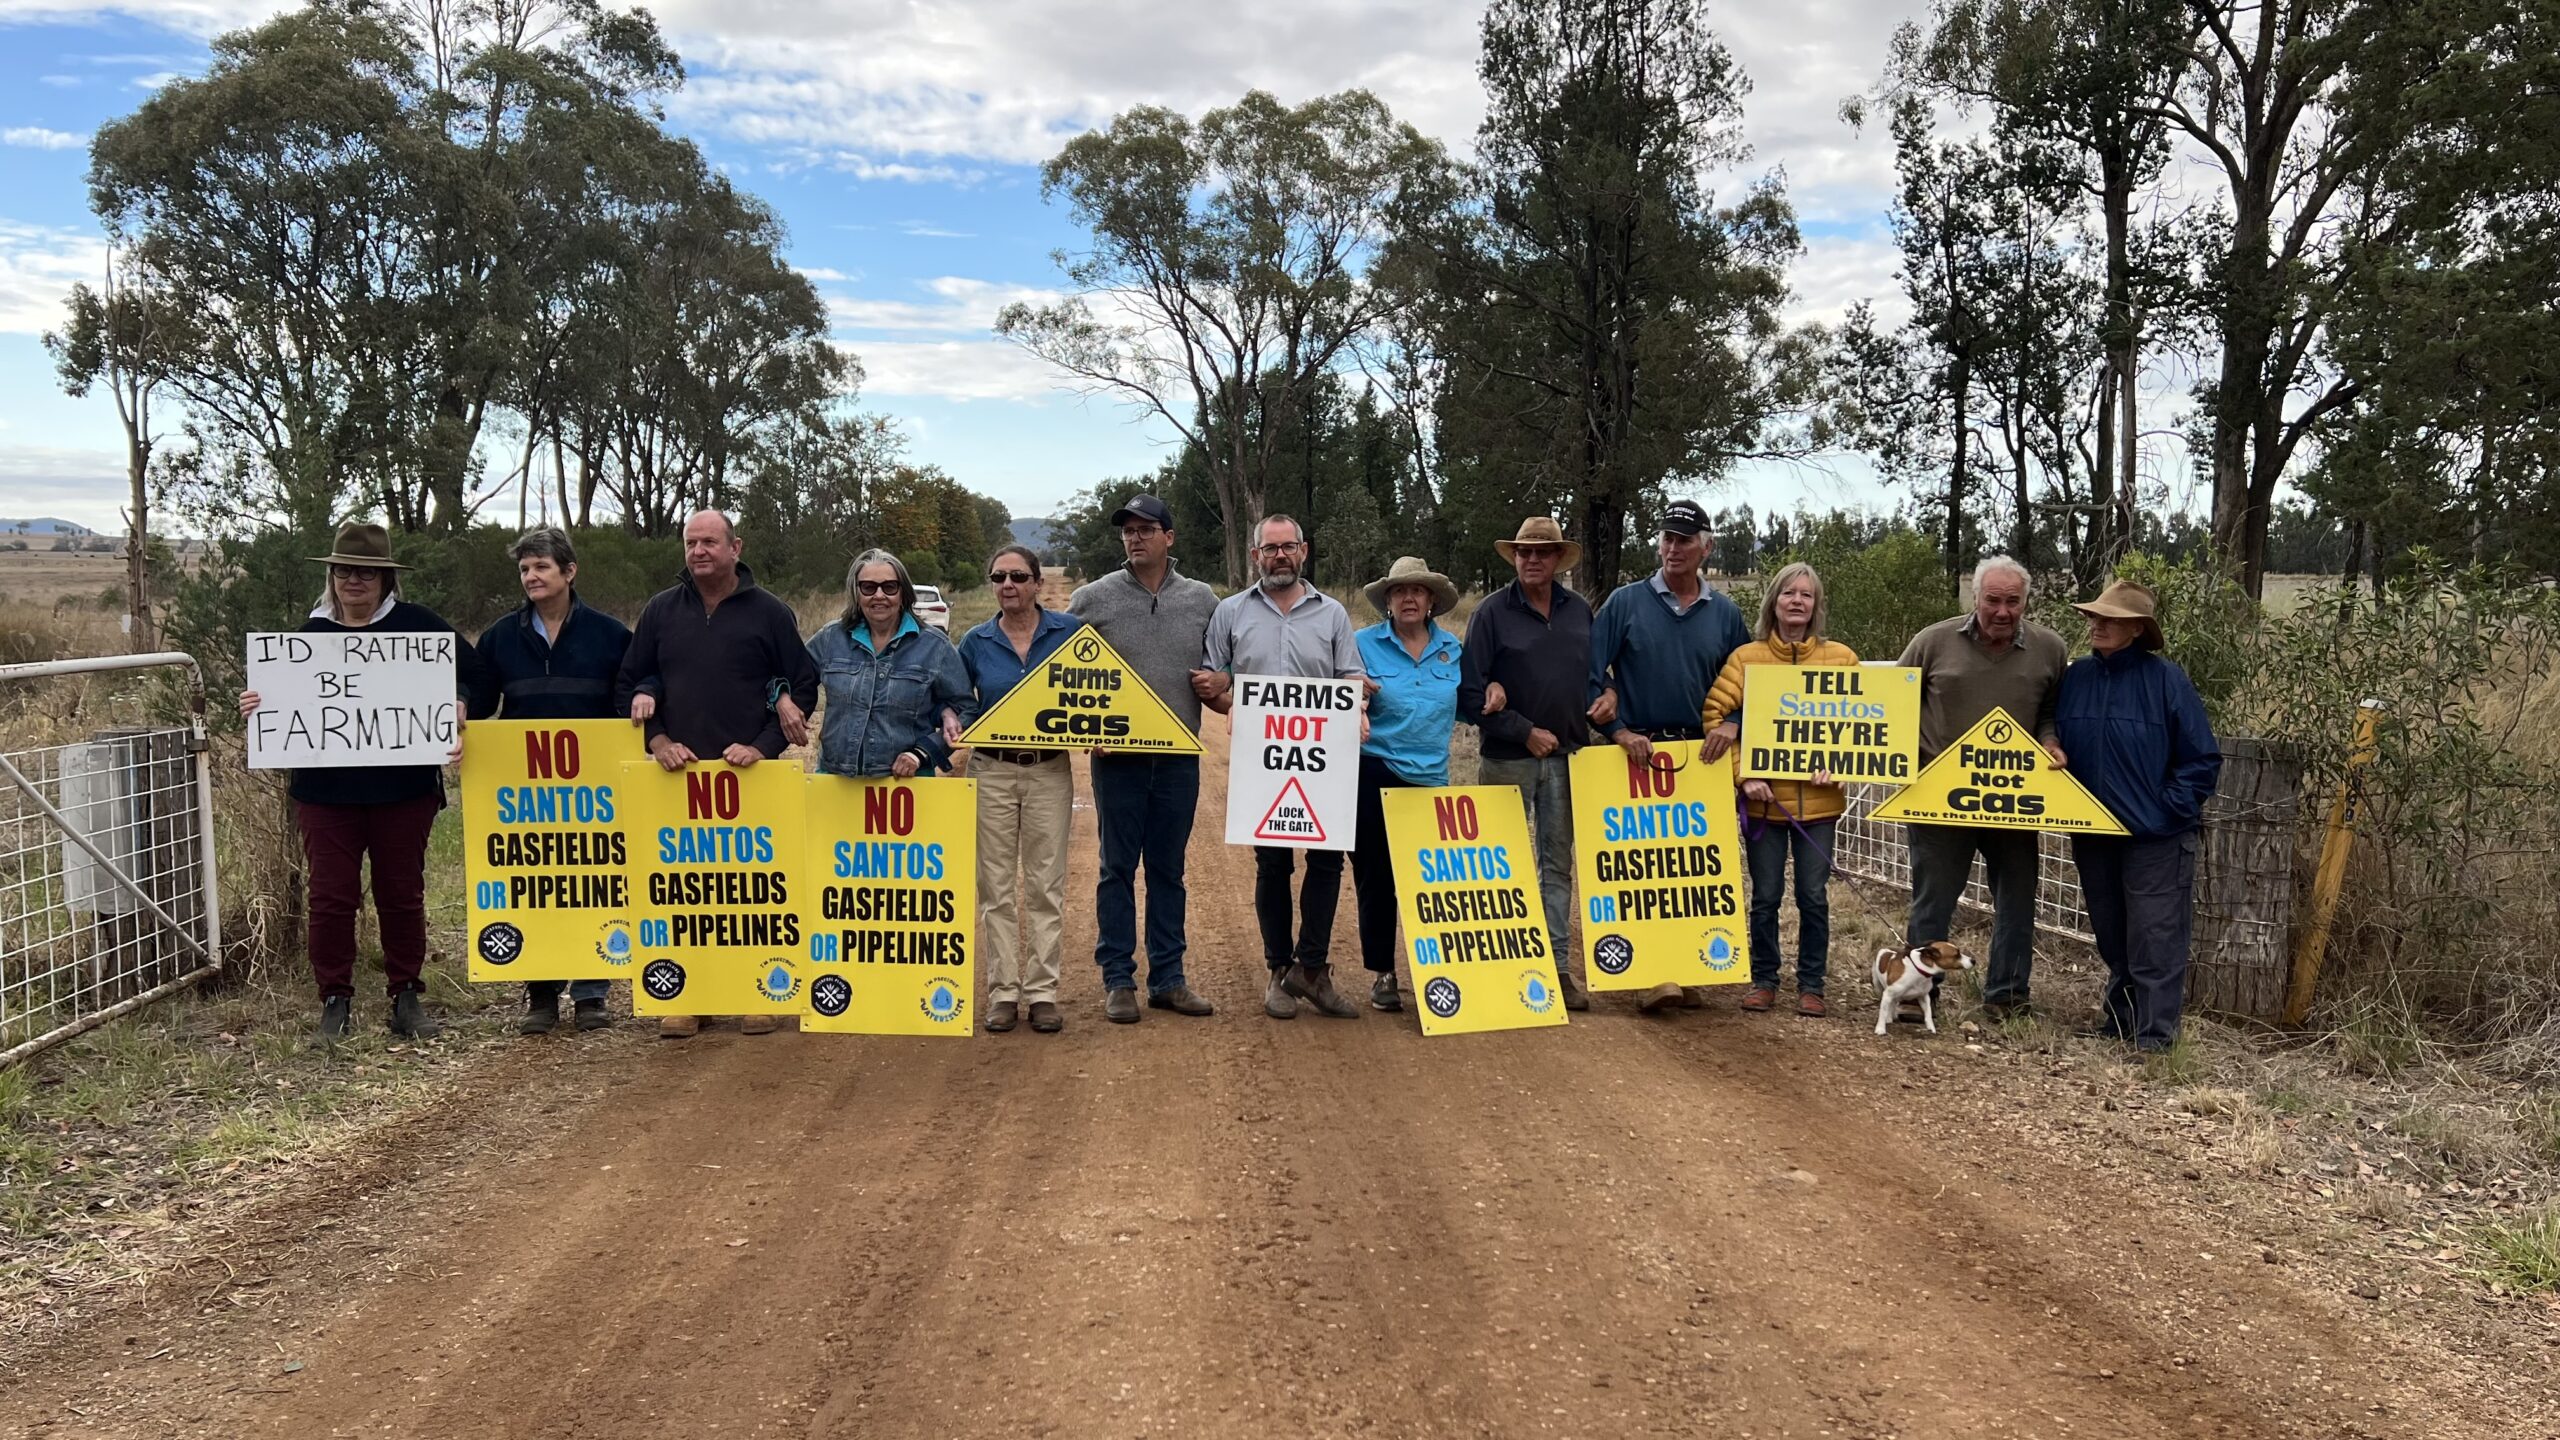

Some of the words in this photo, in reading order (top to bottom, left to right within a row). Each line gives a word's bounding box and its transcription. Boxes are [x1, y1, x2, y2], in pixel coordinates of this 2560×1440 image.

[255, 634, 312, 663] I'D
[344, 636, 452, 664] RATHER
[314, 672, 362, 698] BE
[1047, 662, 1122, 691] Farms
[1802, 671, 1863, 696] TELL
[1059, 692, 1111, 709] Not
[1242, 681, 1354, 711] FARMS
[1779, 692, 1885, 719] Santos
[255, 702, 454, 752] FARMING
[1035, 709, 1130, 736] Gas
[1265, 715, 1328, 741] NOT
[525, 728, 580, 780] NO
[1059, 736, 1125, 745] Liverpool
[1129, 738, 1173, 746] Plains
[1263, 745, 1326, 772] GAS
[1961, 744, 2035, 771] Farms
[1627, 751, 1675, 798] NO
[1751, 748, 1908, 778] DREAMING
[1971, 772, 2024, 788] Not
[496, 785, 615, 824] SANTOS
[685, 769, 741, 820] NO
[863, 784, 915, 837] NO
[1947, 788, 2044, 815] Gas
[1267, 819, 1286, 831] THE
[1289, 820, 1314, 832] GATE
[1279, 807, 1304, 818] LOCK
[1433, 794, 1480, 841] NO
[1602, 801, 1708, 842] SANTOS
[1903, 809, 1938, 817] Save
[1943, 811, 1967, 819] the
[1971, 813, 2040, 823] Liverpool
[2045, 817, 2092, 826] Plains
[487, 832, 625, 867] GASFIELDS
[658, 825, 774, 864] SANTOS
[834, 841, 944, 881] SANTOS
[1418, 846, 1512, 883] SANTOS
[1597, 845, 1721, 882] GASFIELDS
[476, 880, 507, 910] OR
[511, 874, 627, 909] PIPELINE
[649, 872, 787, 905] GASFIELDS
[823, 886, 954, 923] GASFIELDS
[1416, 888, 1527, 924] GASFIELDS
[1589, 895, 1616, 923] OR
[1619, 884, 1736, 921] PIPELINES
[640, 918, 669, 948] OR
[672, 913, 799, 946] PIPELINES
[810, 933, 838, 962] OR
[842, 930, 964, 965] PIPELINES
[1414, 936, 1441, 966] OR
[1440, 927, 1544, 964] PIPELINES
